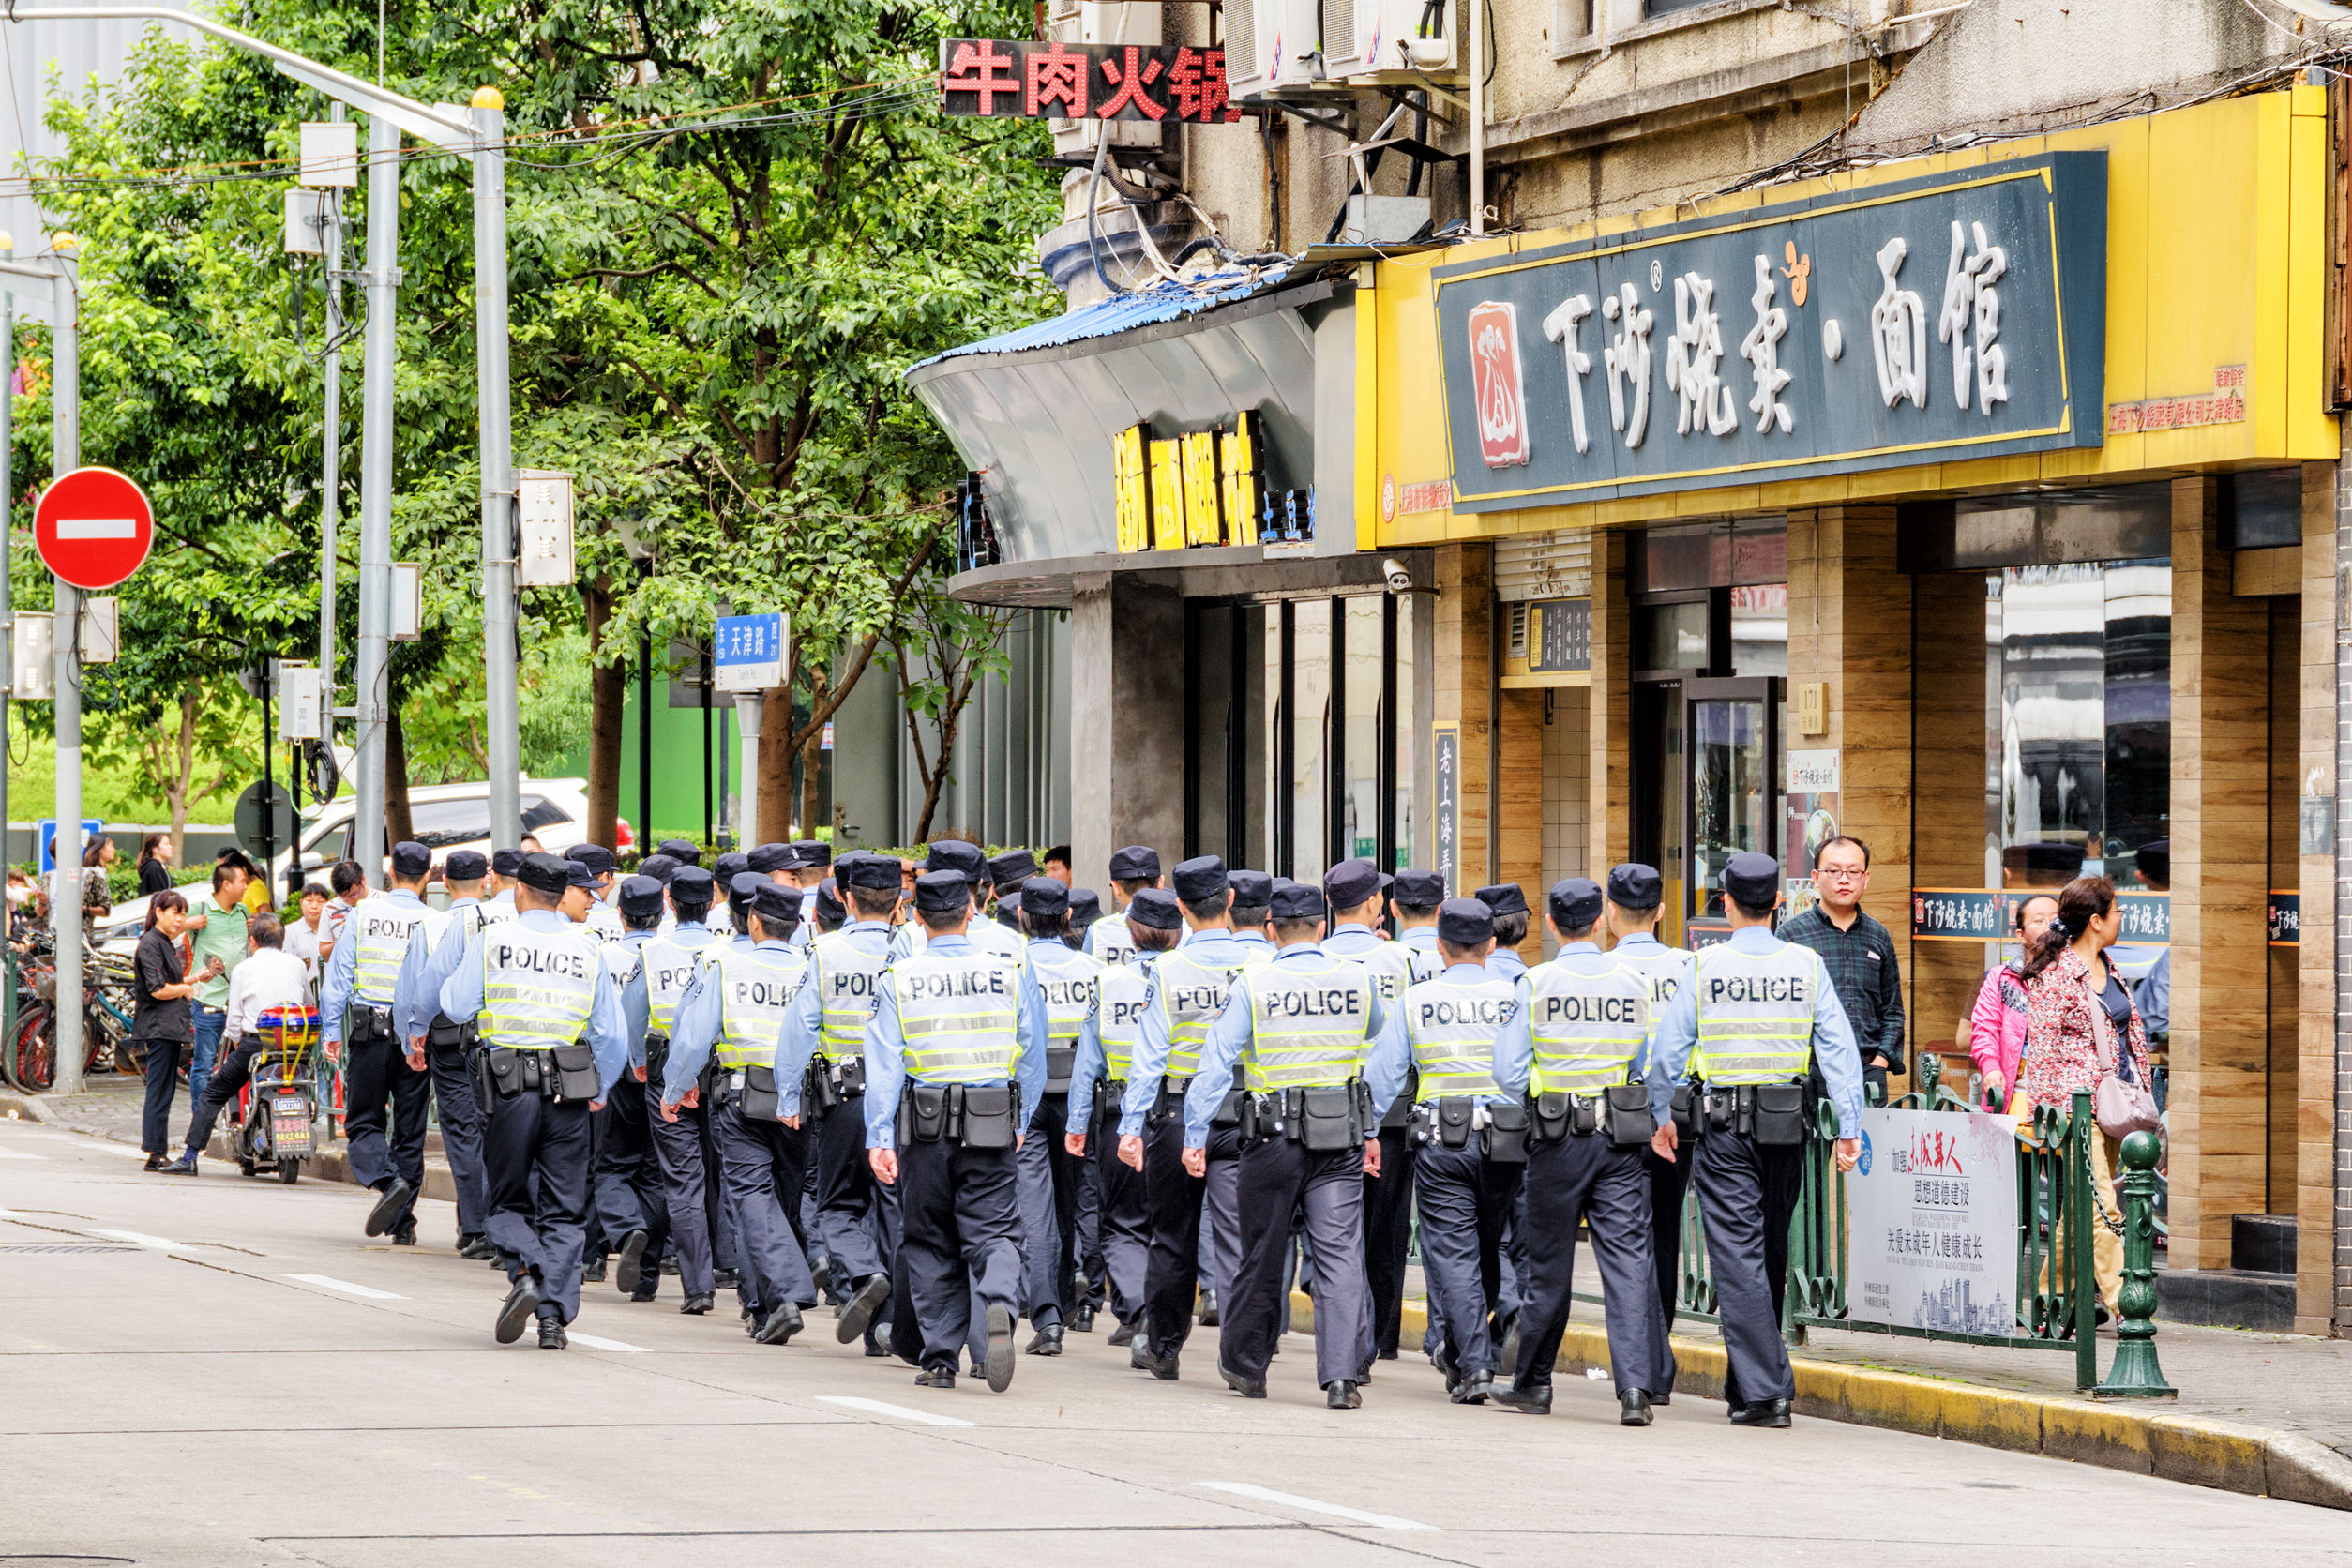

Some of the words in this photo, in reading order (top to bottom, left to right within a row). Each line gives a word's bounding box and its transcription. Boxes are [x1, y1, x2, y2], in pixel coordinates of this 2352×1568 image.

[946, 39, 1242, 122] 牛肉火锅
[731, 624, 764, 656] 天津路
[369, 918, 411, 939] POLI
[500, 944, 584, 978] POLICE
[736, 981, 796, 1007] POLIC
[835, 972, 875, 996] POL
[910, 970, 1003, 1001] POLICE
[1711, 976, 1803, 1003] POLICE
[1177, 986, 1220, 1011] POL
[1267, 989, 1359, 1017] POLICE
[1547, 996, 1635, 1023] POLICE
[1914, 1179, 1969, 1207] 思想道德建设
[1887, 1228, 1982, 1259] 关爱未成年人健康成长
